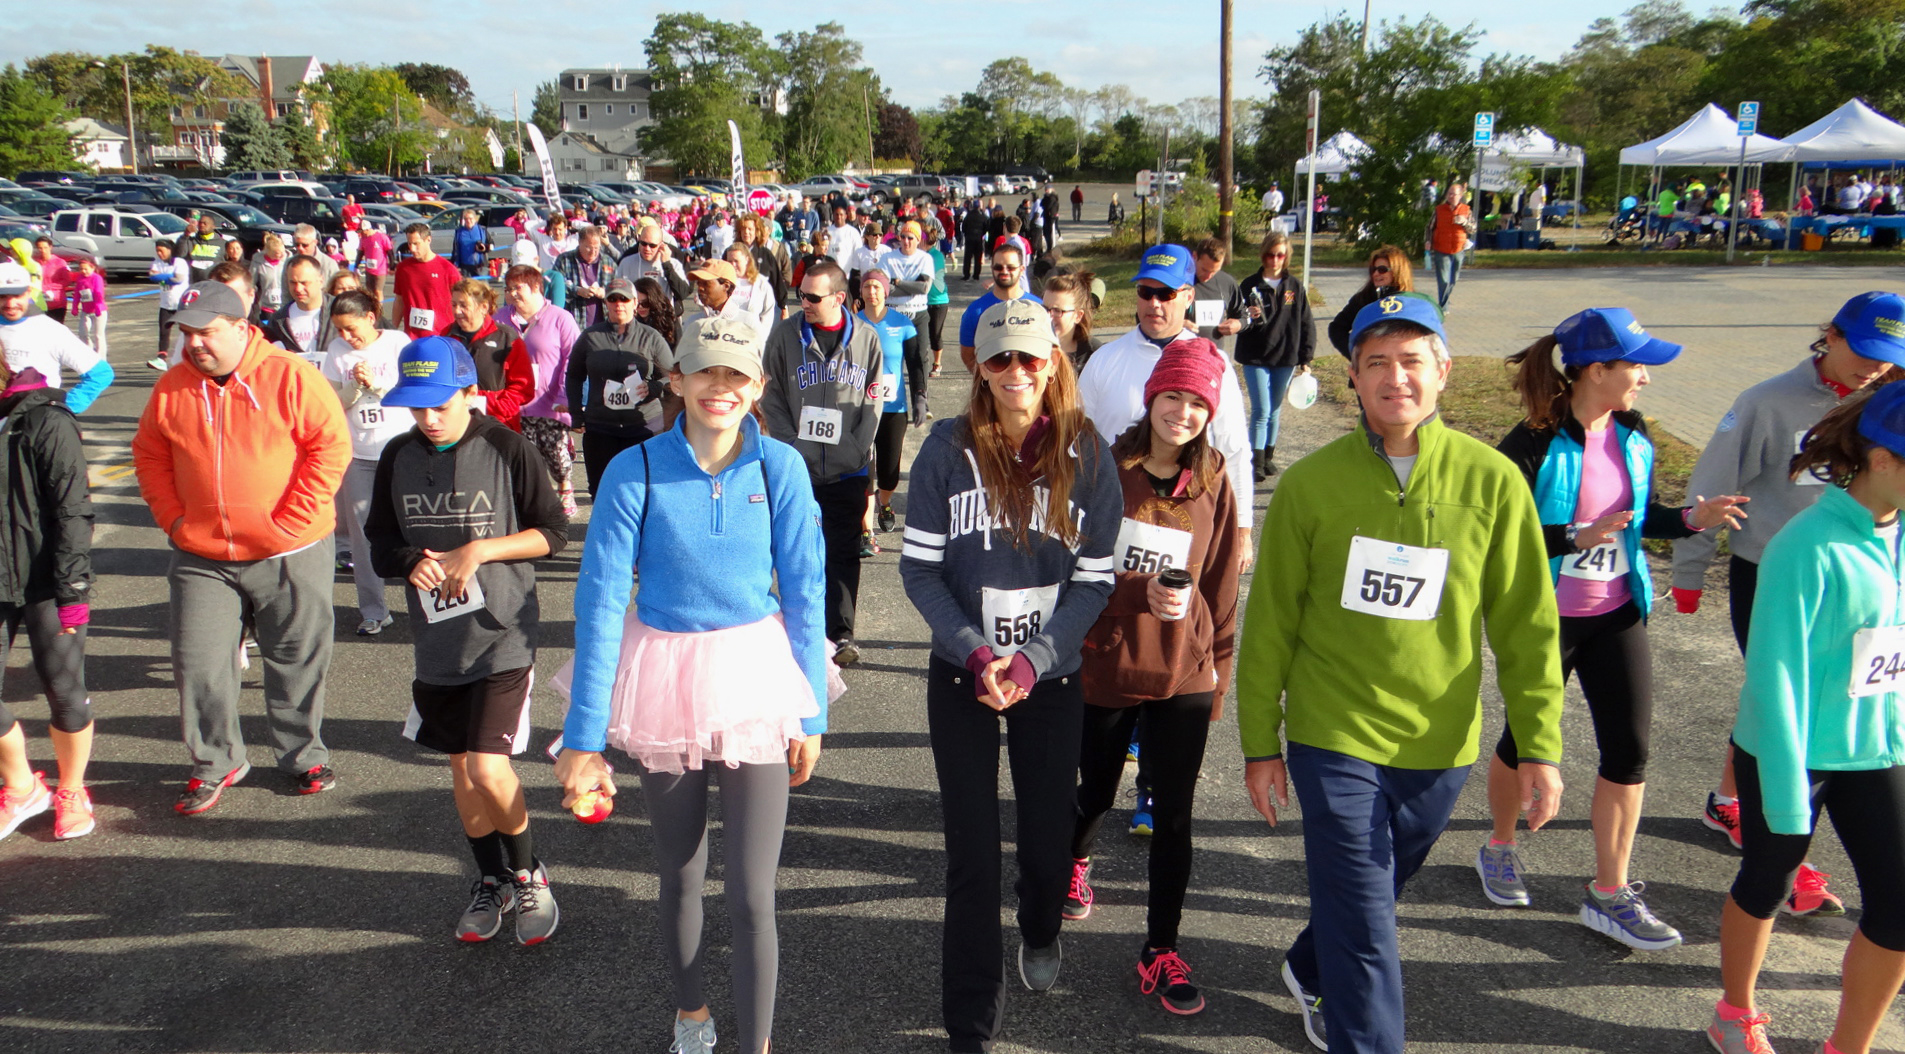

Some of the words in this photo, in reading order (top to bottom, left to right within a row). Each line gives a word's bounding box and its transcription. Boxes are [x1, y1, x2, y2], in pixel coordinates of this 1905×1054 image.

[750, 197, 772, 210] STOP
[413, 315, 428, 326] 175
[797, 360, 867, 391] CHICAGO
[608, 392, 630, 406] 430
[359, 408, 385, 423] 151
[807, 420, 835, 438] 168
[403, 490, 493, 515] RVCA
[1123, 545, 1173, 574] 556
[1573, 547, 1618, 573] 241
[1360, 568, 1427, 608] 557
[995, 610, 1041, 647] 558
